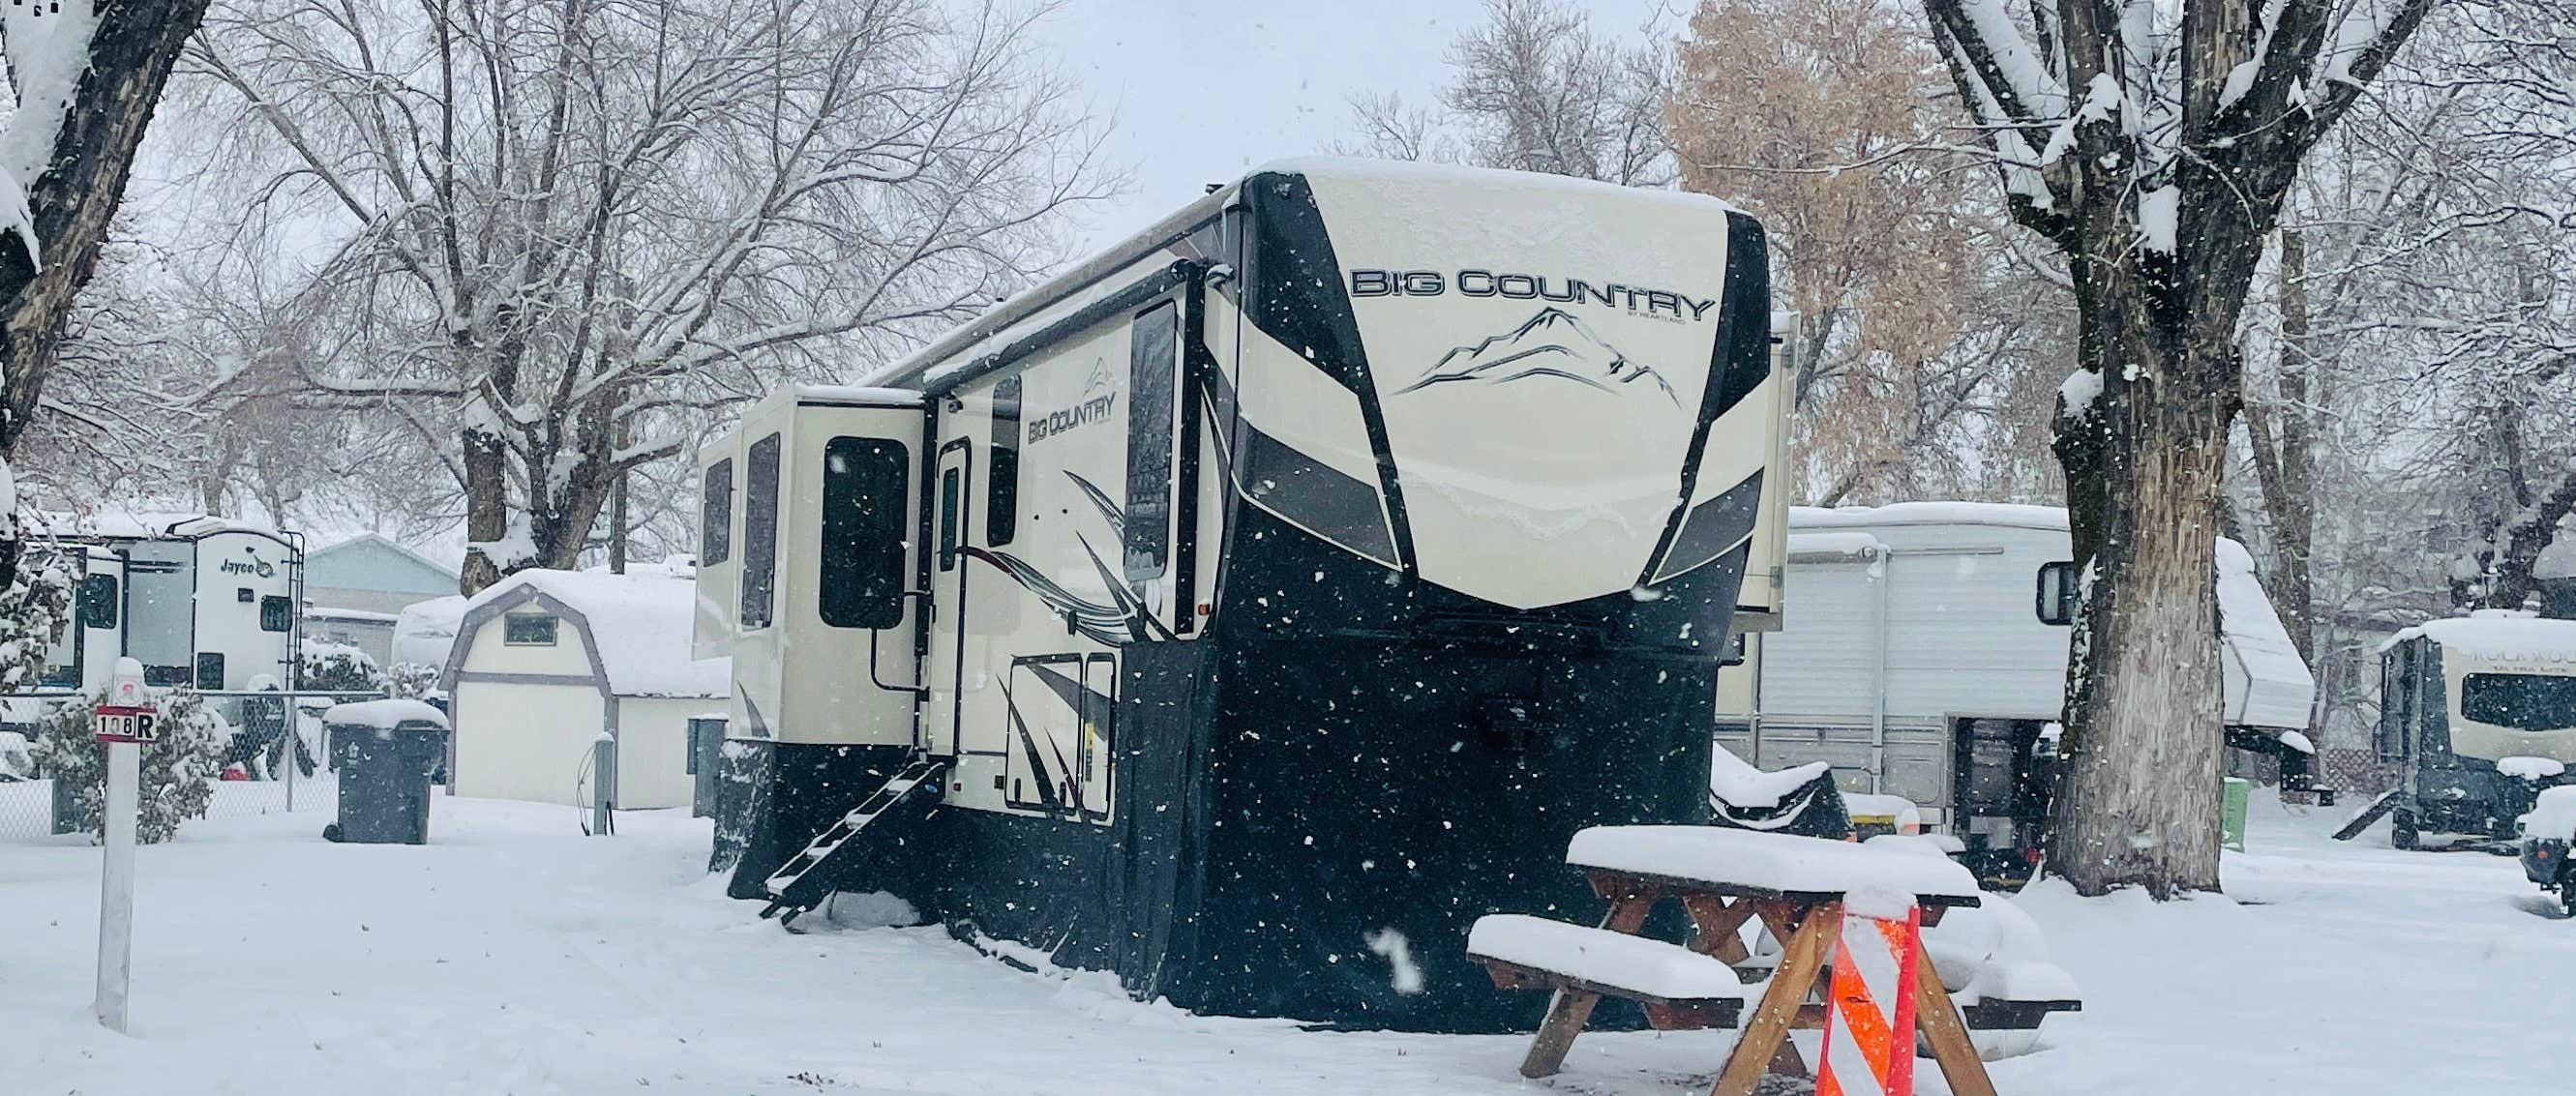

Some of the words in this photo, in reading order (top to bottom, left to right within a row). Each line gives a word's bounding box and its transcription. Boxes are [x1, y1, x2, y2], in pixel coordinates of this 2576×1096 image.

[1350, 270, 1446, 297] BIG
[1456, 270, 1716, 322] COUNTRY
[1049, 391, 1117, 437] COUNTRY
[221, 558, 255, 576] Jayco
